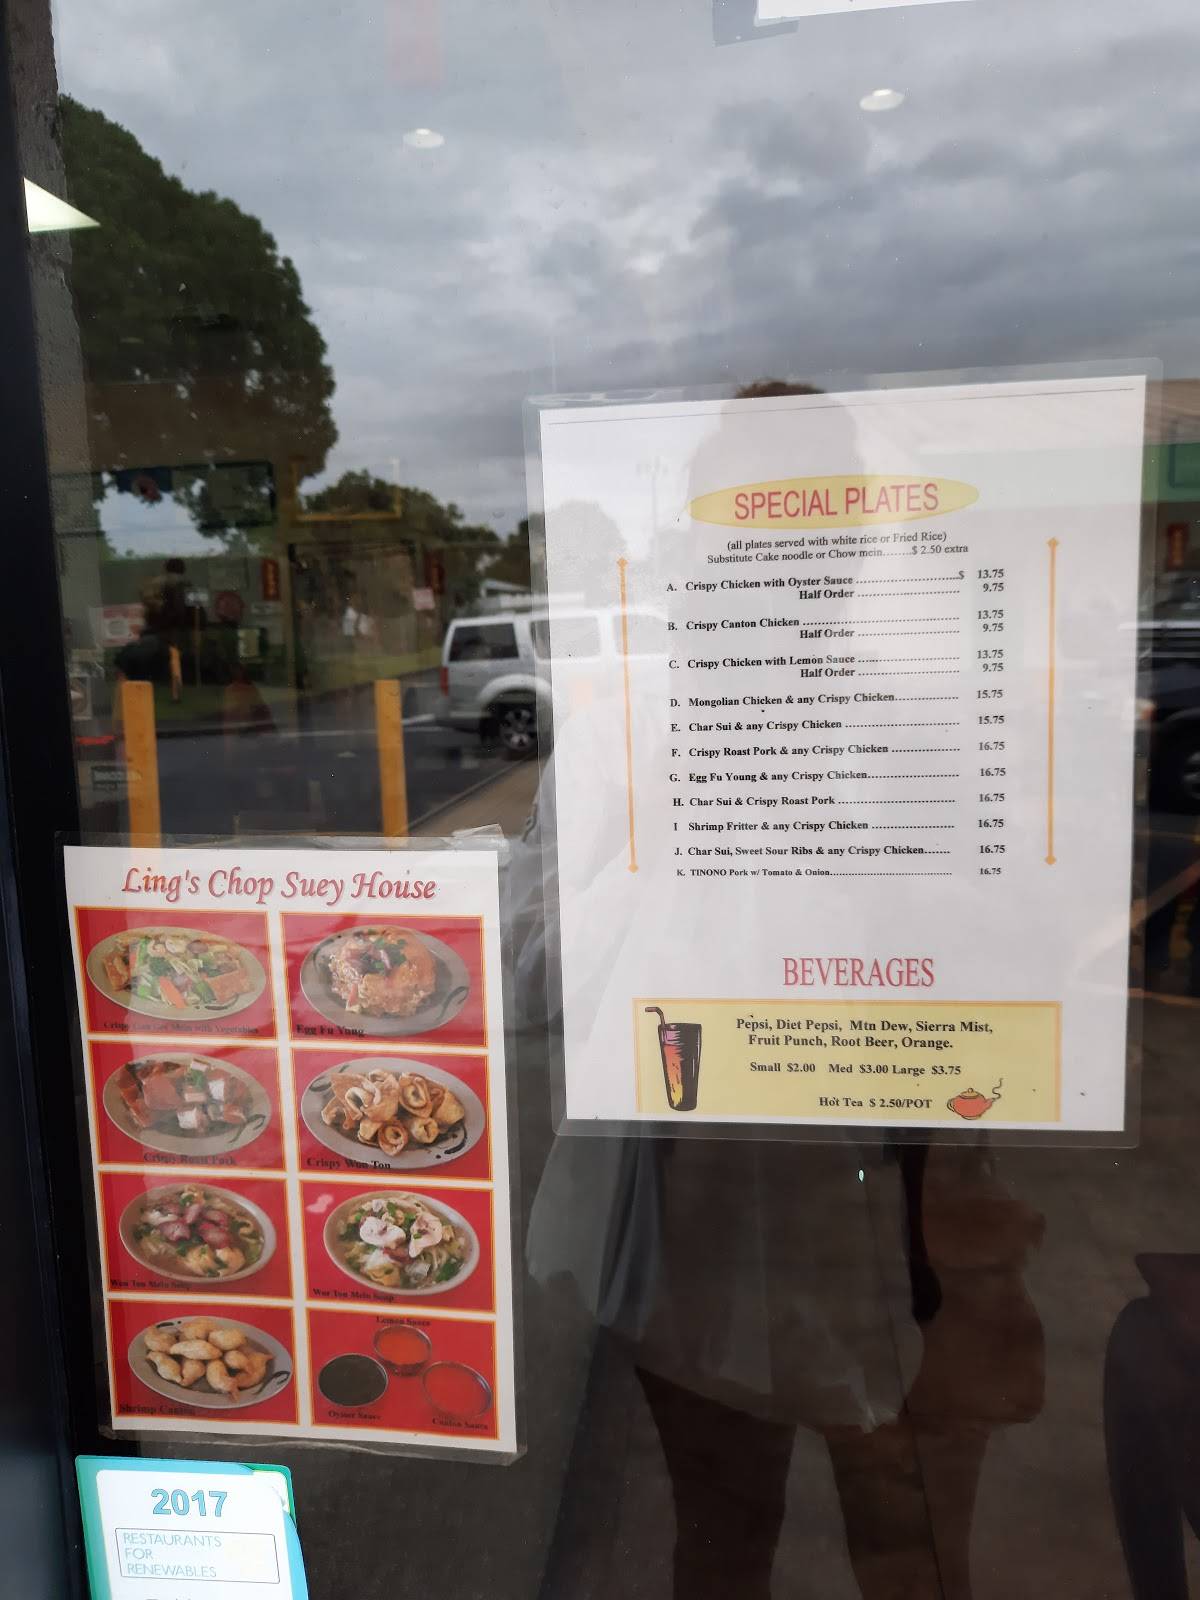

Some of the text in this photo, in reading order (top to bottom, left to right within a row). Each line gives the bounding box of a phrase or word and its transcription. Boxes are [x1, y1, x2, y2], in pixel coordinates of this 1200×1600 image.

[734, 483, 939, 519] SPECIAL PLATES
[727, 532, 947, 551] (all plates served with white rice or Fried Rice)
[708, 545, 968, 564] Substitute Cake noodle or Chow 2.50 extra
[666, 569, 1004, 592] A. Crispy Chicken with Oyster Sauce 13.75
[799, 582, 1004, 600] Half Order 9.75
[668, 610, 1004, 632] B. Crispy Canton Chicken 13.75
[800, 622, 1004, 639] Half Order 9.75
[669, 650, 1004, 670] C. Crispy Chicken with Lemon Sauce 13.75
[800, 662, 1004, 678] Half Order 9.75
[670, 689, 1003, 708] D. Mongolian Chicken & any Crispy Chicken 15.75
[671, 715, 1005, 732] E. Char Sui & any Crispy Chicken 15.75
[671, 741, 1005, 758] F. Crispy Roast Pork & any Crispy Chicken 16.75
[669, 767, 1006, 783] G. Egg Fu Young & any Crispy Chicken 16.75
[673, 793, 1005, 807] H. Char Sui & Crispy Roast Pork 16.75
[688, 818, 1004, 833] Shrimp Fritter & any Crispy Chicken 16.75
[674, 844, 1005, 857] J. Char Sui, Sweet Sour Ribs & any Crispy Chicken 16.75
[690, 868, 727, 876] TINONO
[729, 868, 748, 876] Pork
[751, 868, 759, 876] w/
[762, 868, 792, 876] Tomato
[795, 868, 802, 876] &
[805, 868, 830, 876] Onion
[122, 867, 436, 905] Ling's Chop Suey House
[783, 957, 935, 987] BEVERAGES
[296, 1024, 333, 1035] Egg Fu
[736, 1018, 993, 1034] Pepsi, Diet Pepsi, Mtn Dew, Sierra Mist,
[748, 1034, 953, 1050] Fruit Punch, Root Beer, Orange.
[750, 1062, 961, 1077] Small $2.00 Med $3.00 Large $3.75
[819, 1097, 932, 1109] Hot Tea $ 2.50/POT
[307, 1158, 390, 1169] Crispy Ton
[376, 1316, 404, 1325] Lemon
[328, 1410, 356, 1419] Oyster
[151, 1488, 227, 1517] 2017
[123, 1533, 222, 1547] RESTAURANTS
[125, 1548, 153, 1560] FOR
[127, 1564, 216, 1577] RENEWABLES
